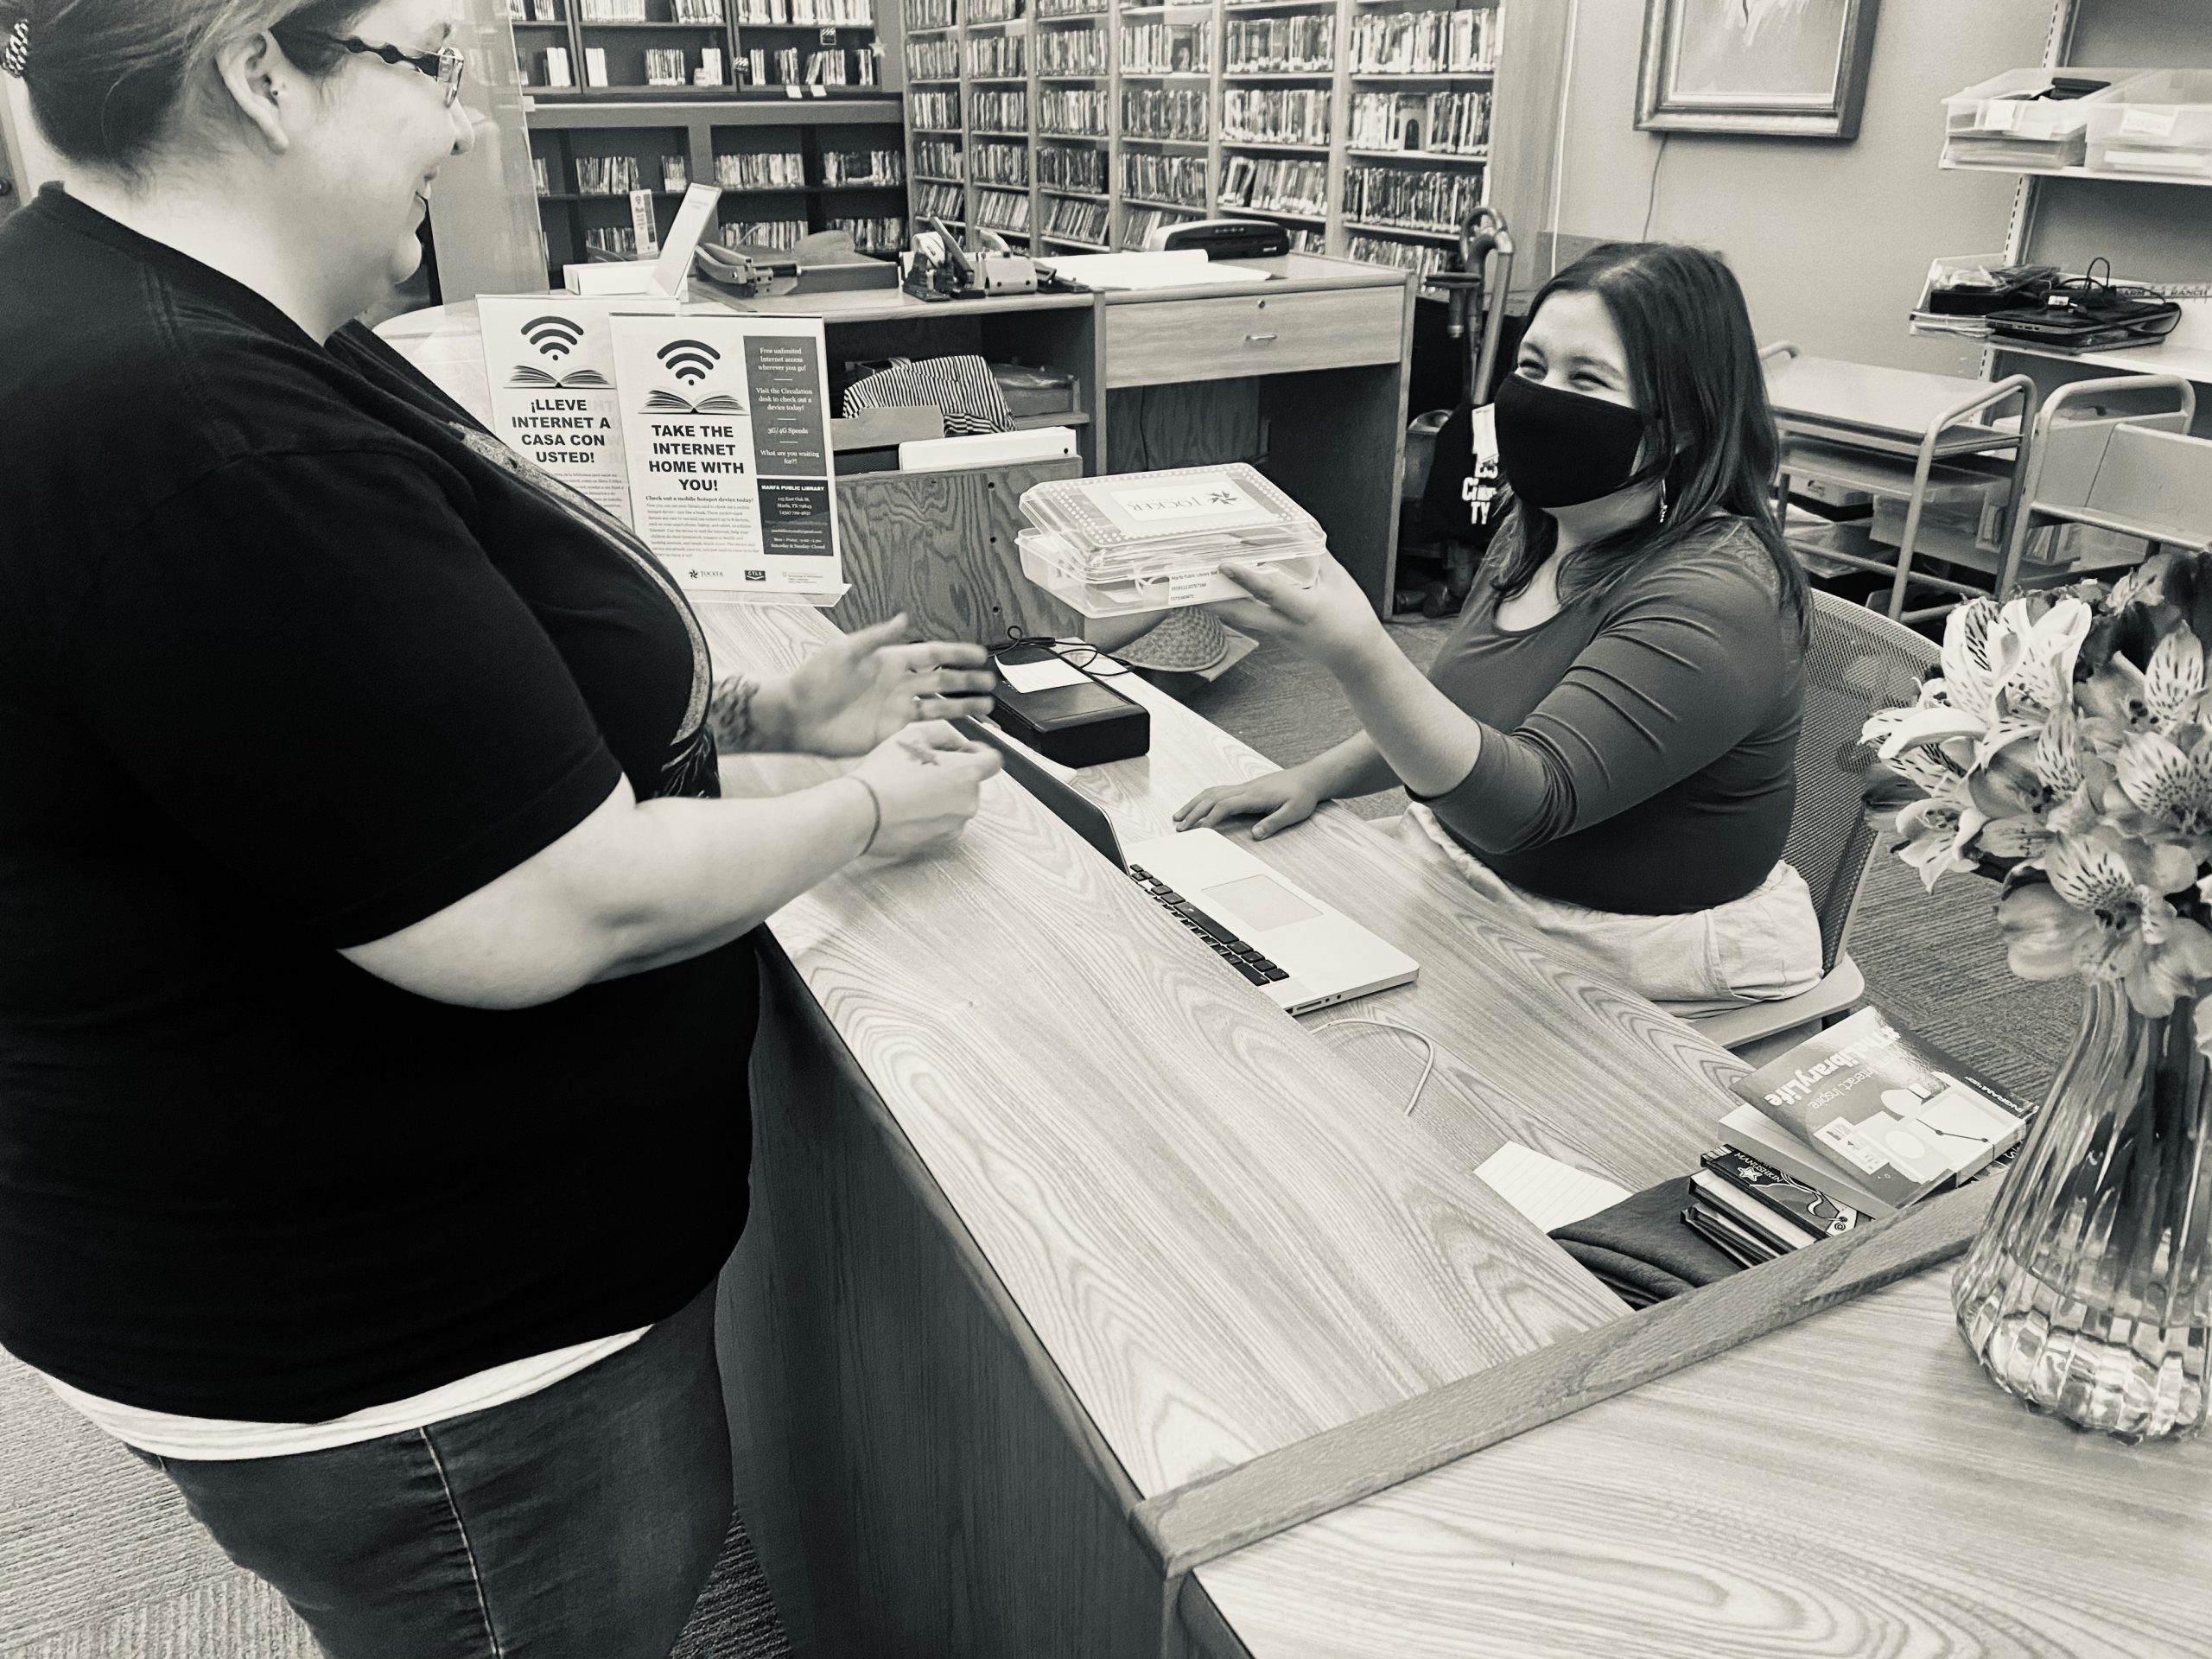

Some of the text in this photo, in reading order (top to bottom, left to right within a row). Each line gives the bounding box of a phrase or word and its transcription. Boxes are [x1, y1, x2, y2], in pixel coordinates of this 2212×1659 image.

[797, 364, 807, 372] go!
[531, 399, 588, 413] ¡LLEVE
[785, 404, 804, 412] today!
[512, 416, 612, 429] INTERNET A
[652, 424, 734, 438] TAKE THE
[521, 434, 605, 446] CASA CON
[652, 442, 736, 456] INTERNET
[536, 451, 595, 463] USTED!
[648, 460, 745, 474] HOME WITH
[677, 479, 718, 492] YOU!
[1733, 1152, 1784, 1183] MANUSHKIN
